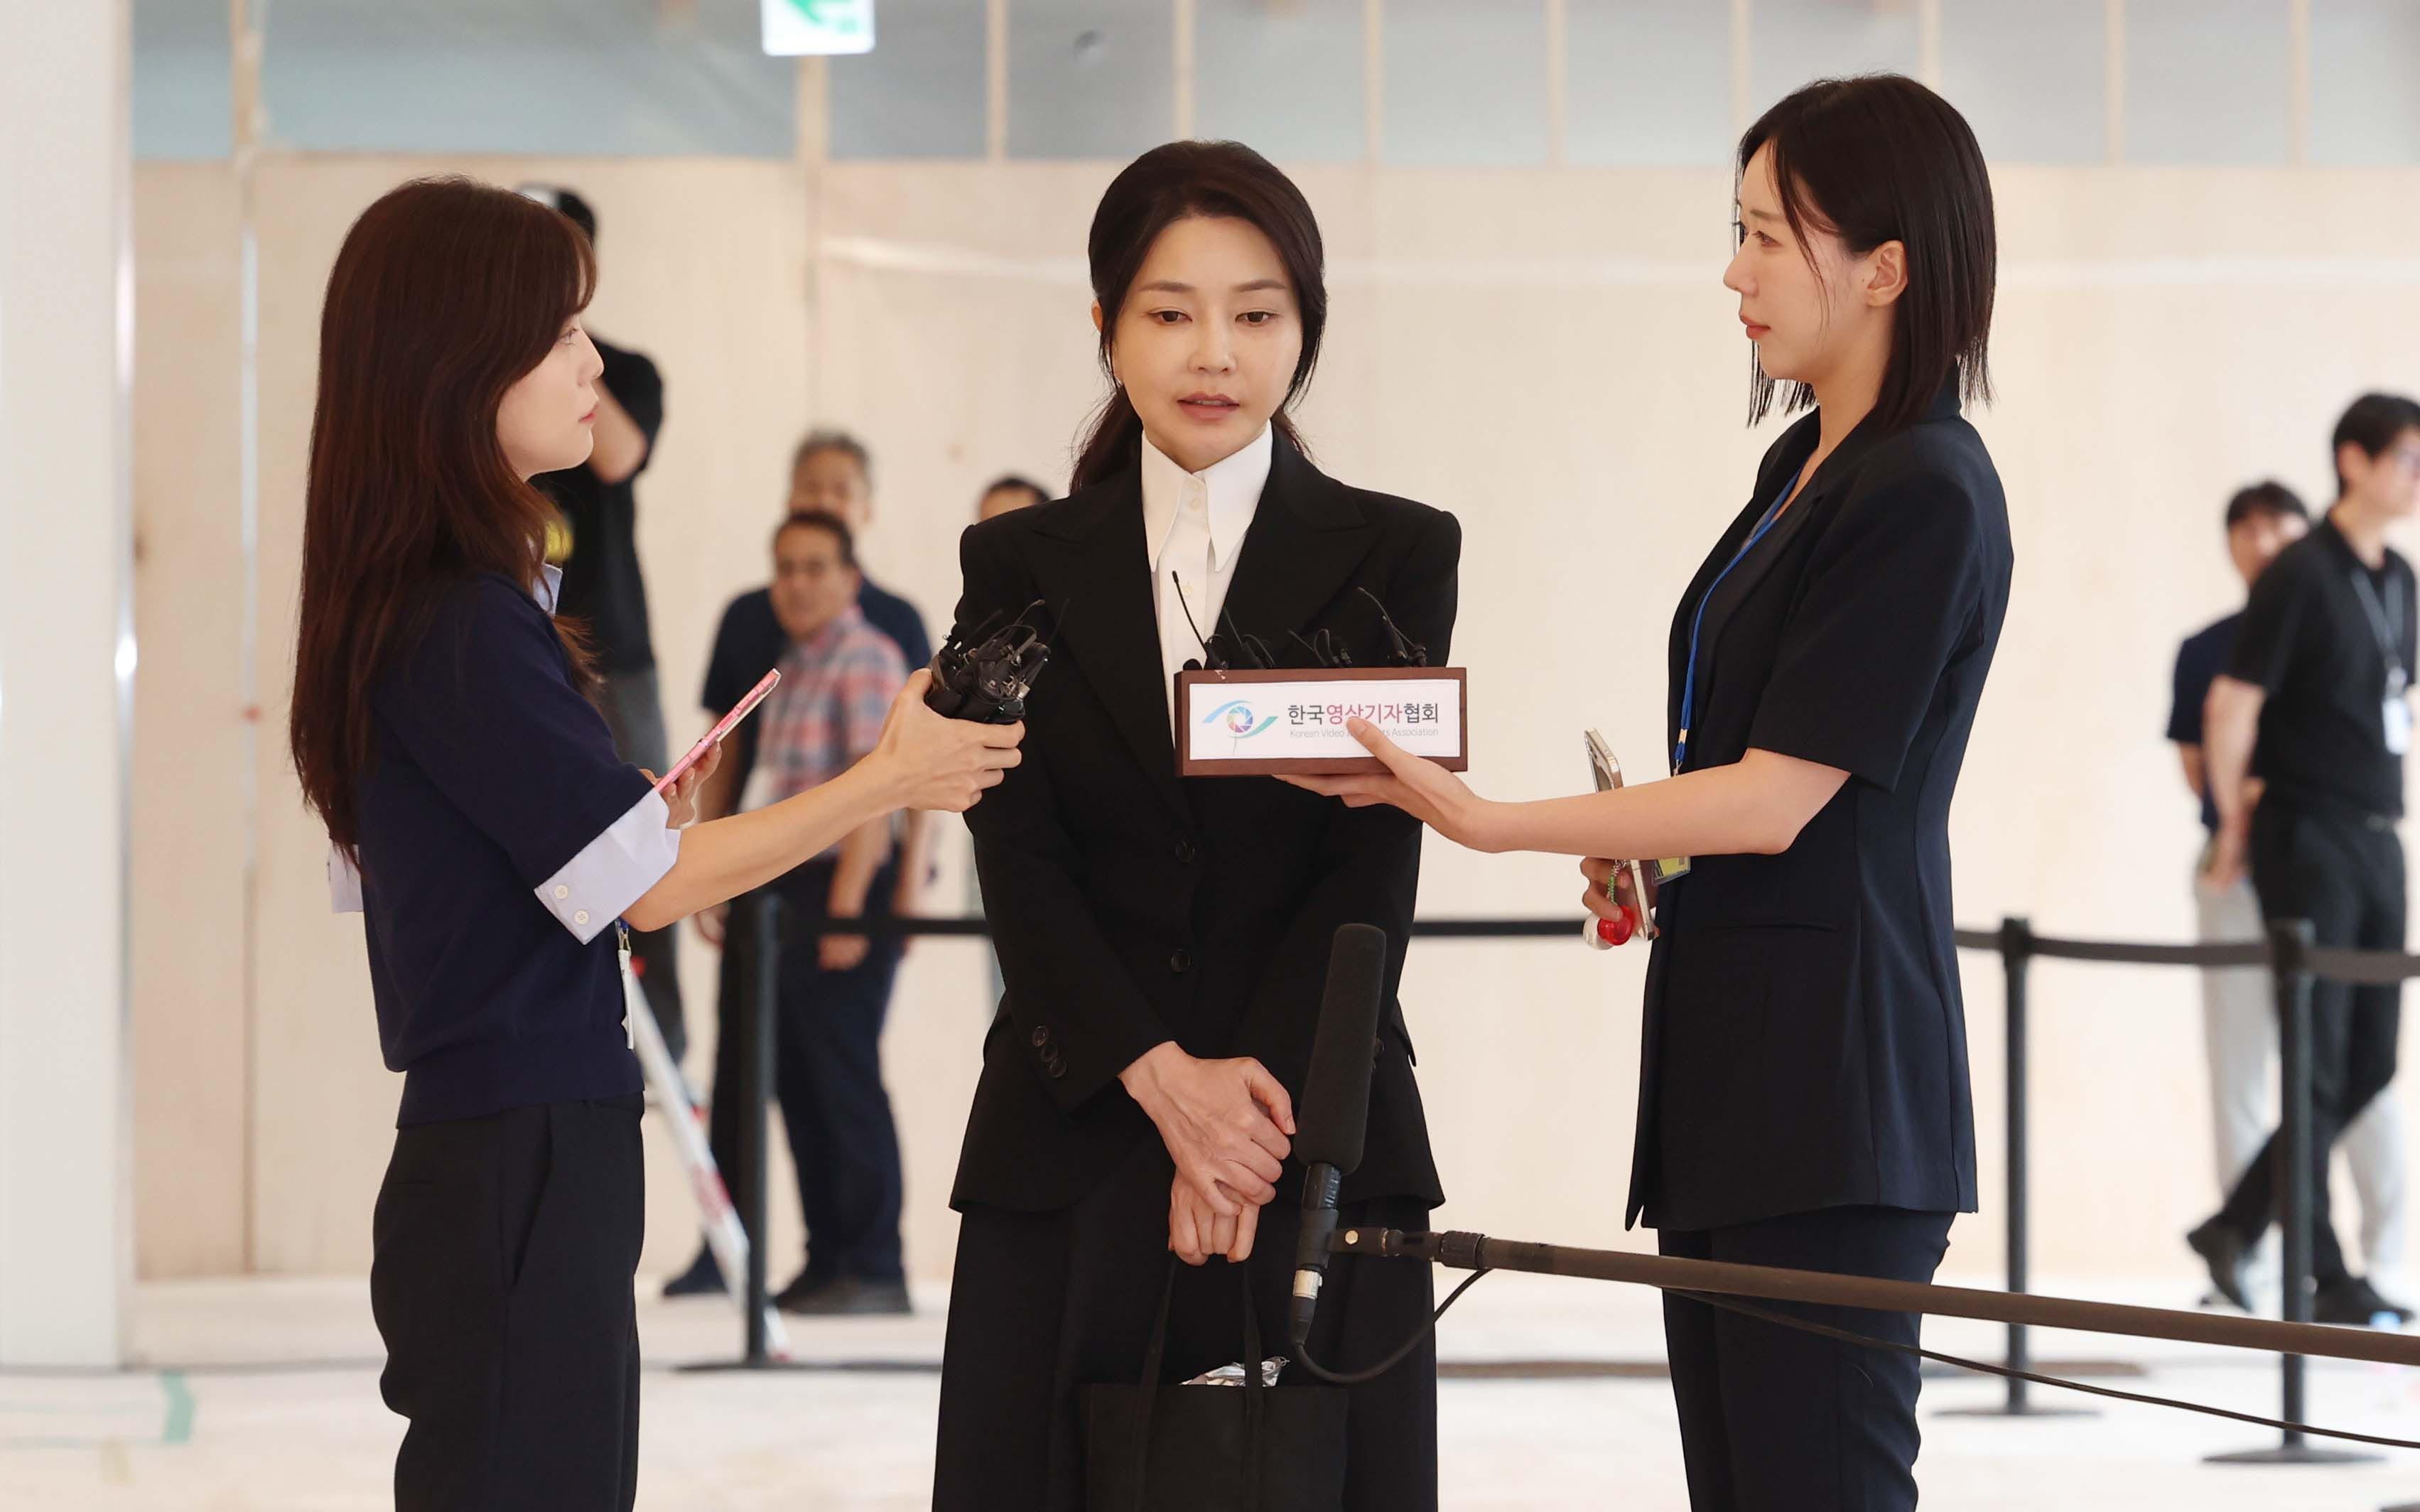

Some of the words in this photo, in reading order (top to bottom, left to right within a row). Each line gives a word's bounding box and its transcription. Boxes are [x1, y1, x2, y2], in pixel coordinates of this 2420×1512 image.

[1290, 728, 1319, 738] Korean
[1321, 728, 1345, 738] Video
[1392, 727, 1439, 737] Association
